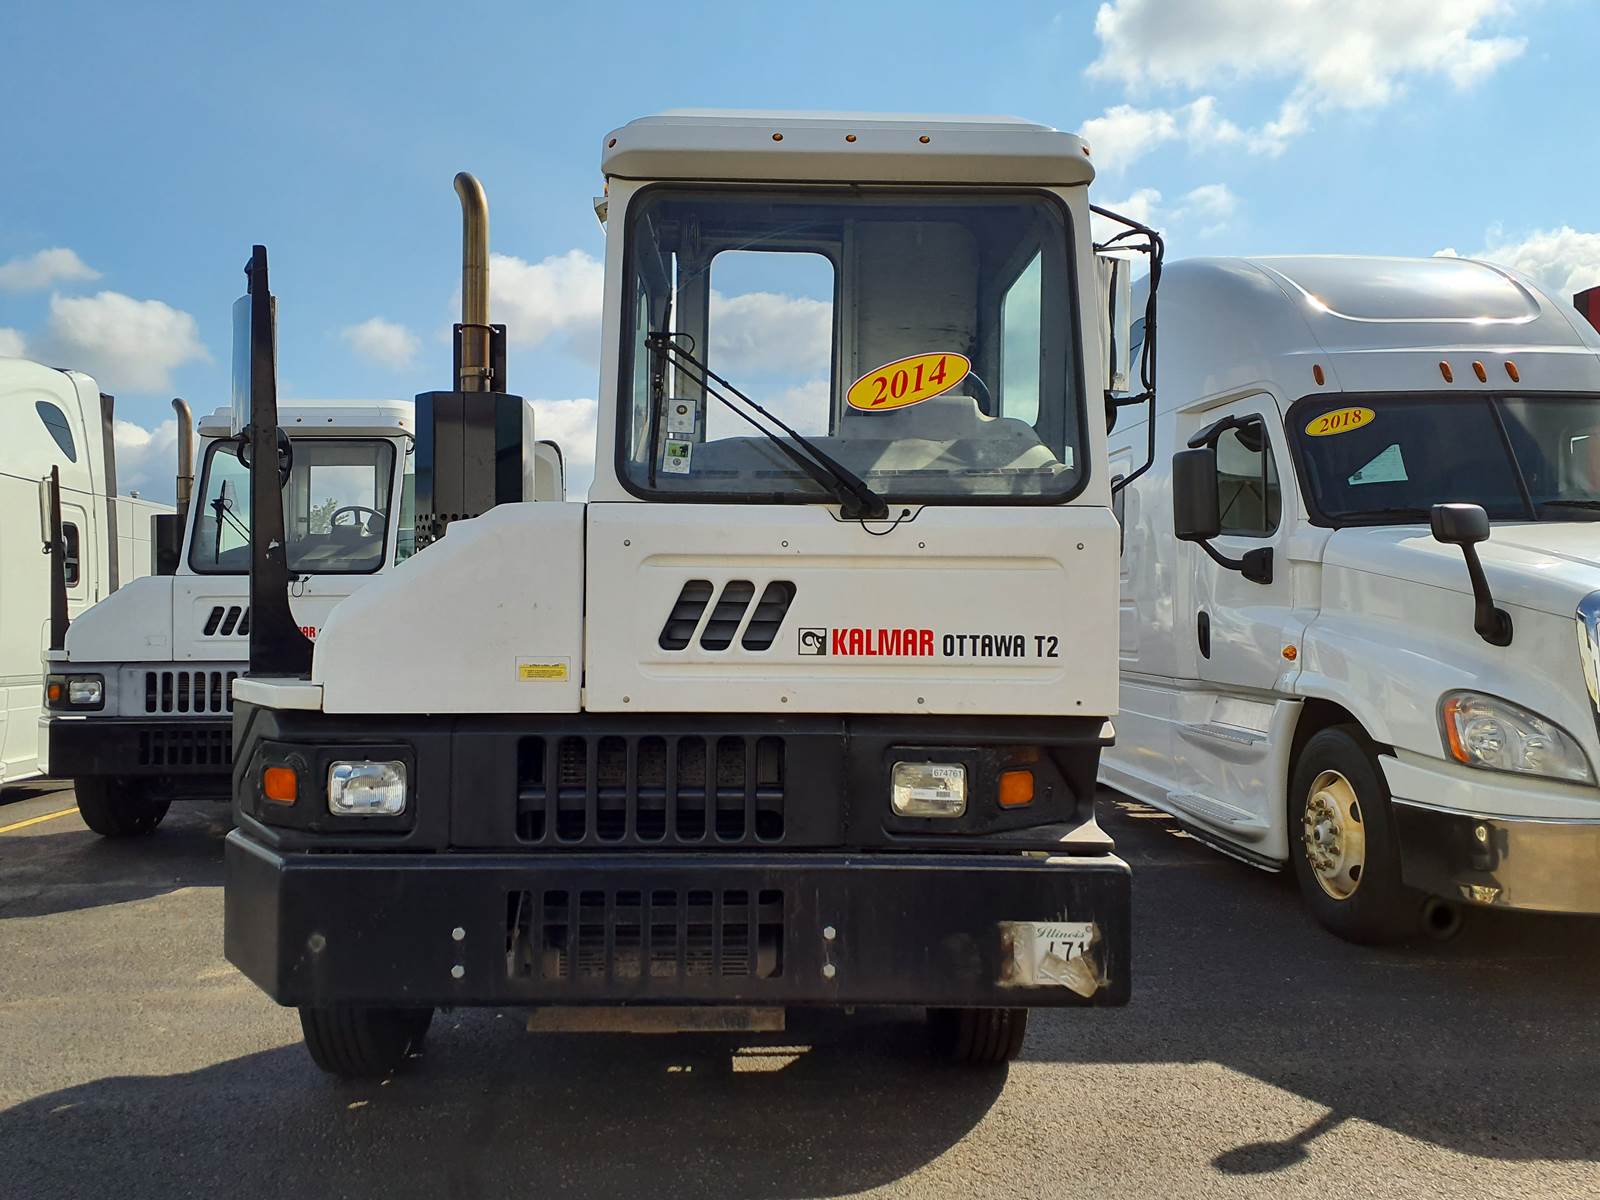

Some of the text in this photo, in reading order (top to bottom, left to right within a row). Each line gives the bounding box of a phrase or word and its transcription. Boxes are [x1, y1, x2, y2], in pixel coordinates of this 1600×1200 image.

[870, 355, 947, 406] 2014
[1320, 409, 1362, 432] 2018
[832, 628, 1059, 657] KALMAR OTTAWA T2
[1036, 927, 1086, 938] Illinois
